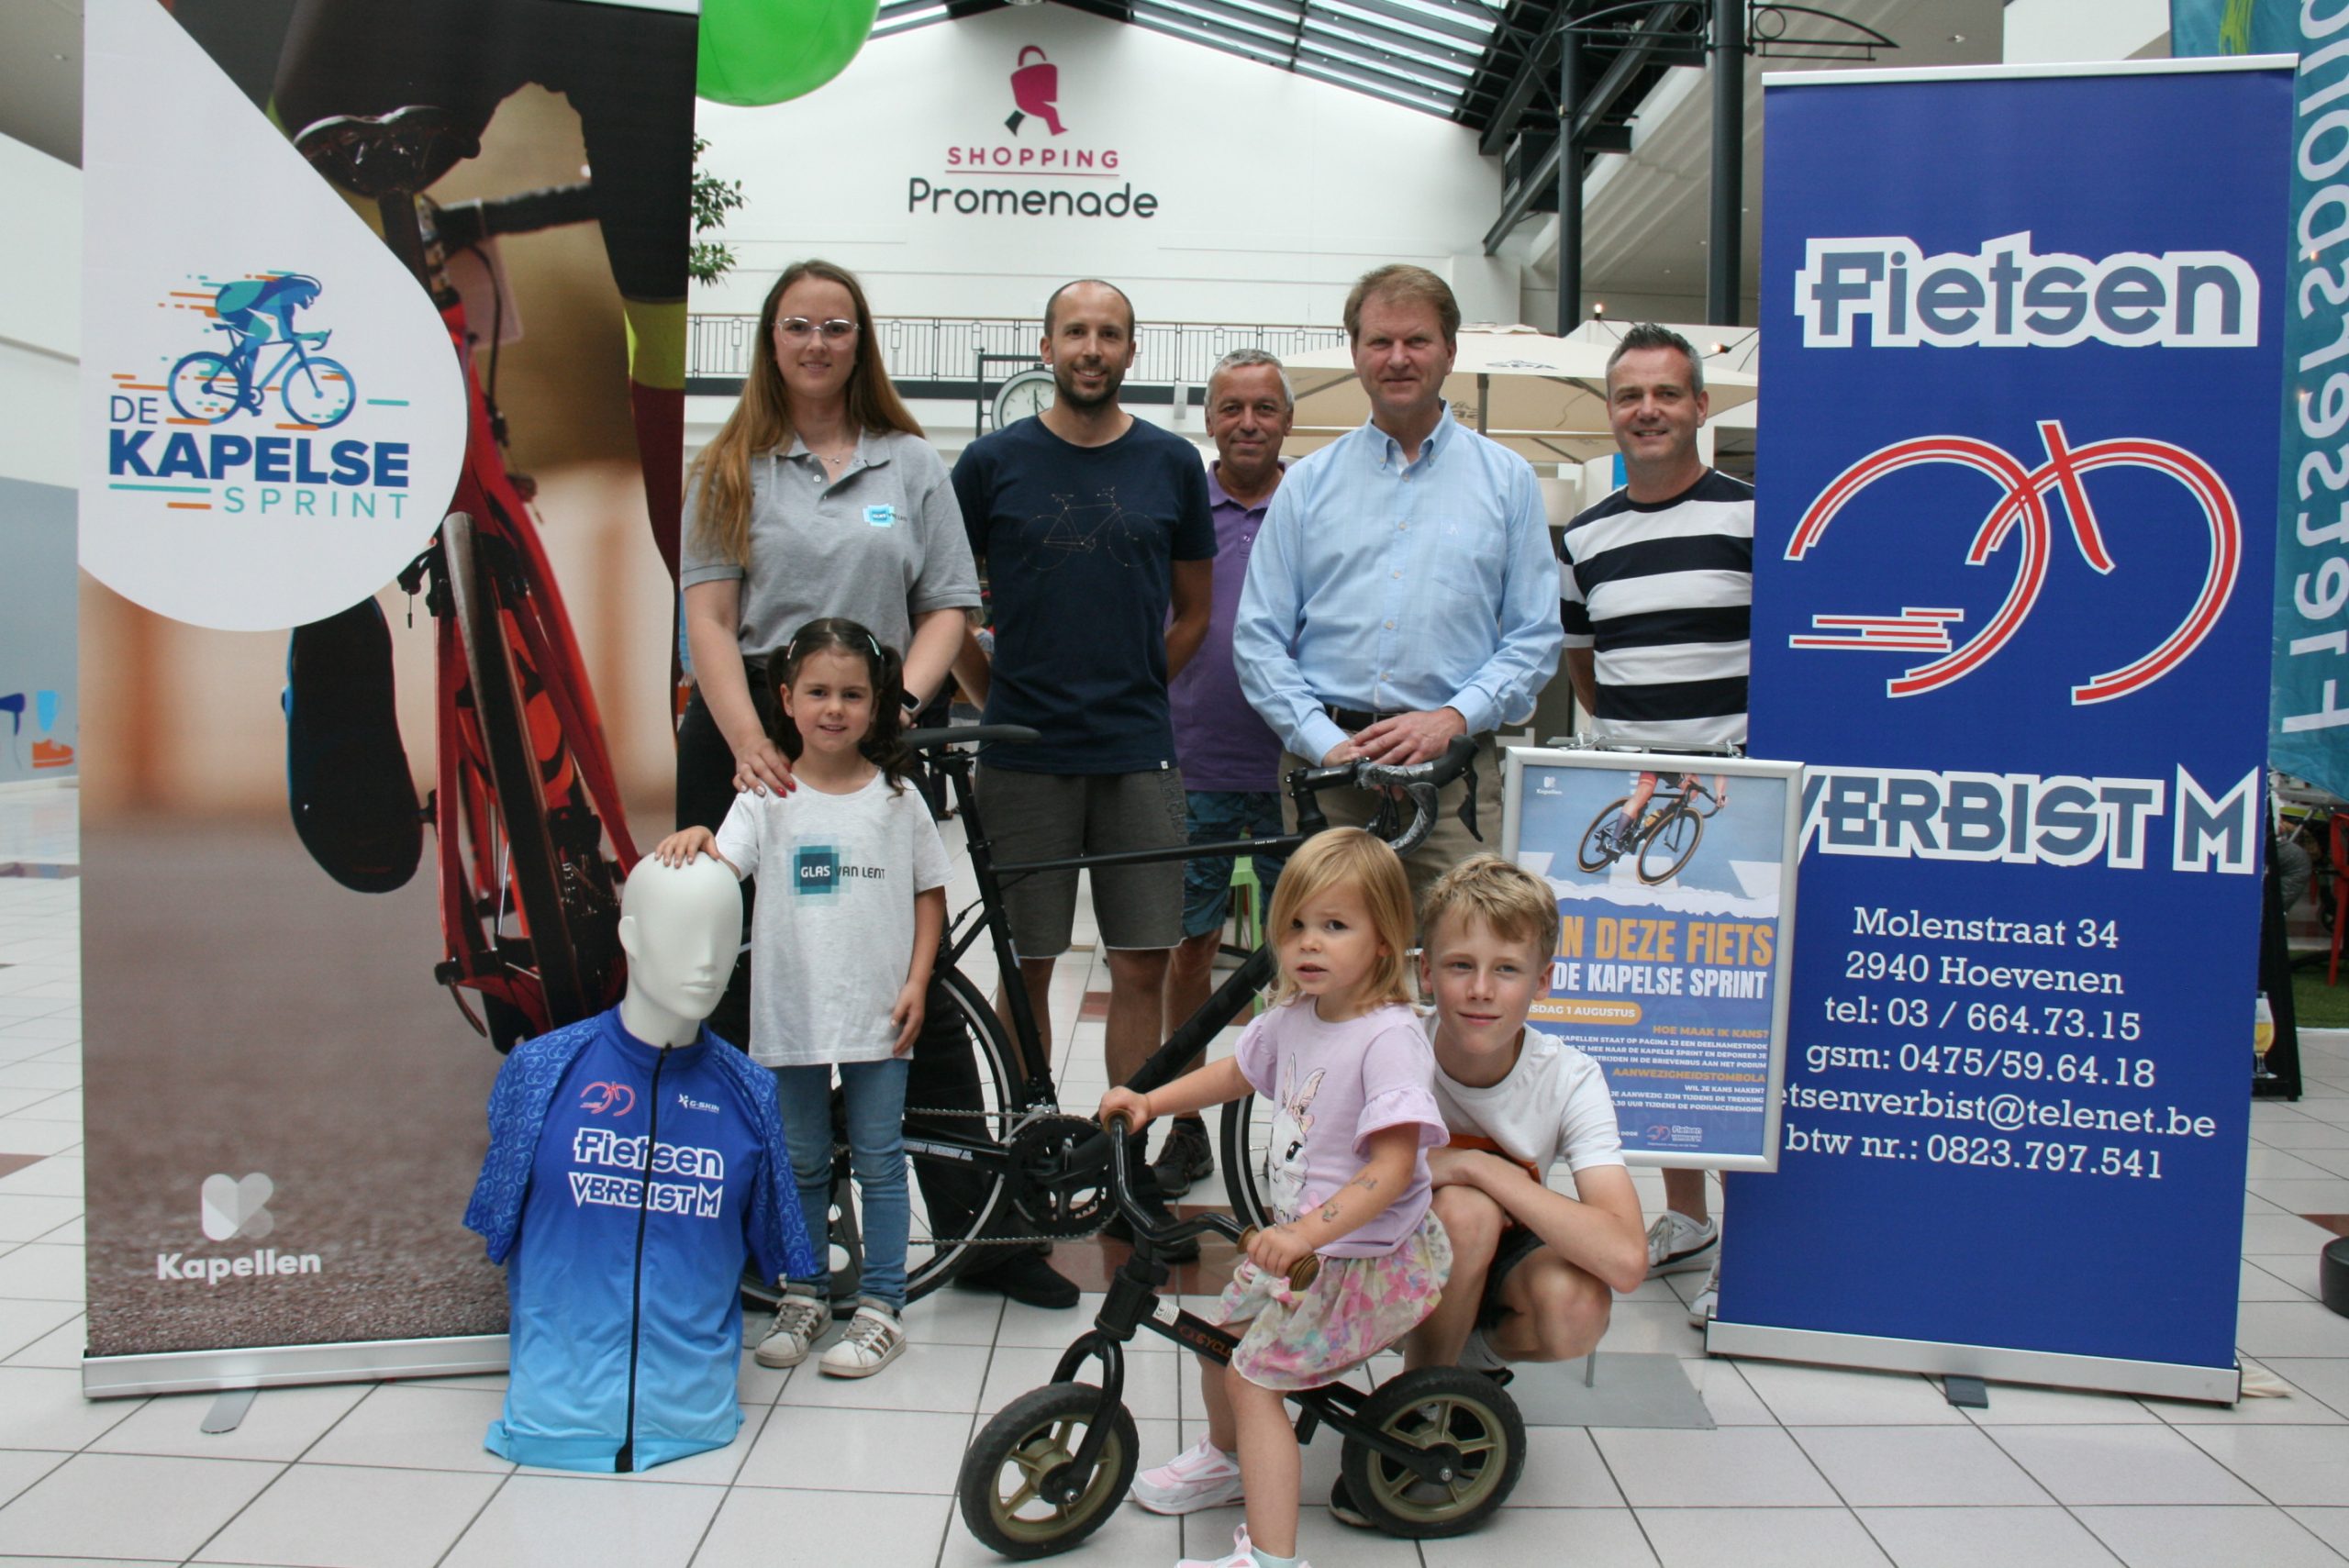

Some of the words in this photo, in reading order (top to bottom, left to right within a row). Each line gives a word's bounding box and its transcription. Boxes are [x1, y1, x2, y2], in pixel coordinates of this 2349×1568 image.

[947, 147, 1119, 169] SHOPPING
[908, 177, 1158, 217] Promenade
[1795, 230, 2260, 348] Fietsen
[110, 395, 159, 424] DE
[109, 428, 409, 488] KAPELSE
[224, 487, 408, 519] SPRINT
[2173, 762, 2259, 874] M
[800, 865, 830, 878] GLAS
[835, 865, 859, 877] VAN
[863, 867, 885, 880] LENT
[1595, 917, 1676, 962] DEZE
[1687, 921, 1775, 967] FIETS
[1853, 906, 2066, 946] Molenstraat
[2076, 919, 2120, 949] 34
[1553, 962, 1580, 991] DE
[1587, 963, 1683, 996] KAPELSE
[1689, 968, 1767, 999] SPRINT
[1845, 951, 1929, 983] 2940
[1939, 956, 2124, 995] Hoevenen
[1566, 1006, 1572, 1015] 1
[1574, 1006, 1635, 1018] AUGUSTUS
[1653, 1025, 1677, 1035] HOE
[1680, 1027, 1715, 1037] MAAK
[1718, 1029, 1730, 1037] IK
[1731, 1029, 1769, 1039] KANS?
[1825, 996, 1878, 1025] tel:
[1887, 998, 1927, 1027] 03
[1939, 1001, 1957, 1029] /
[1966, 1005, 2141, 1041] 664.73.15
[1652, 1057, 1700, 1066] BRIEVENBUS
[1697, 1041, 1768, 1050] DEELNAMESTROOK
[1717, 1051, 1757, 1059] DEPONEER
[1806, 1044, 1890, 1074] gsm:
[1899, 1043, 2156, 1088] 0475/59.64.18
[1612, 1067, 1766, 1083] AANWEZIGHEIDSTOMBOLA
[1782, 1083, 2216, 1138] tsenverbist@telenet.be
[573, 1127, 724, 1180] Fietsen
[1786, 1123, 1852, 1155] btw
[1861, 1136, 1918, 1160] nr.:
[1927, 1134, 2163, 1179] 0823.797.541
[568, 1172, 696, 1214] VERBIST
[696, 1182, 723, 1218] M
[157, 1249, 321, 1284] Kapellen
